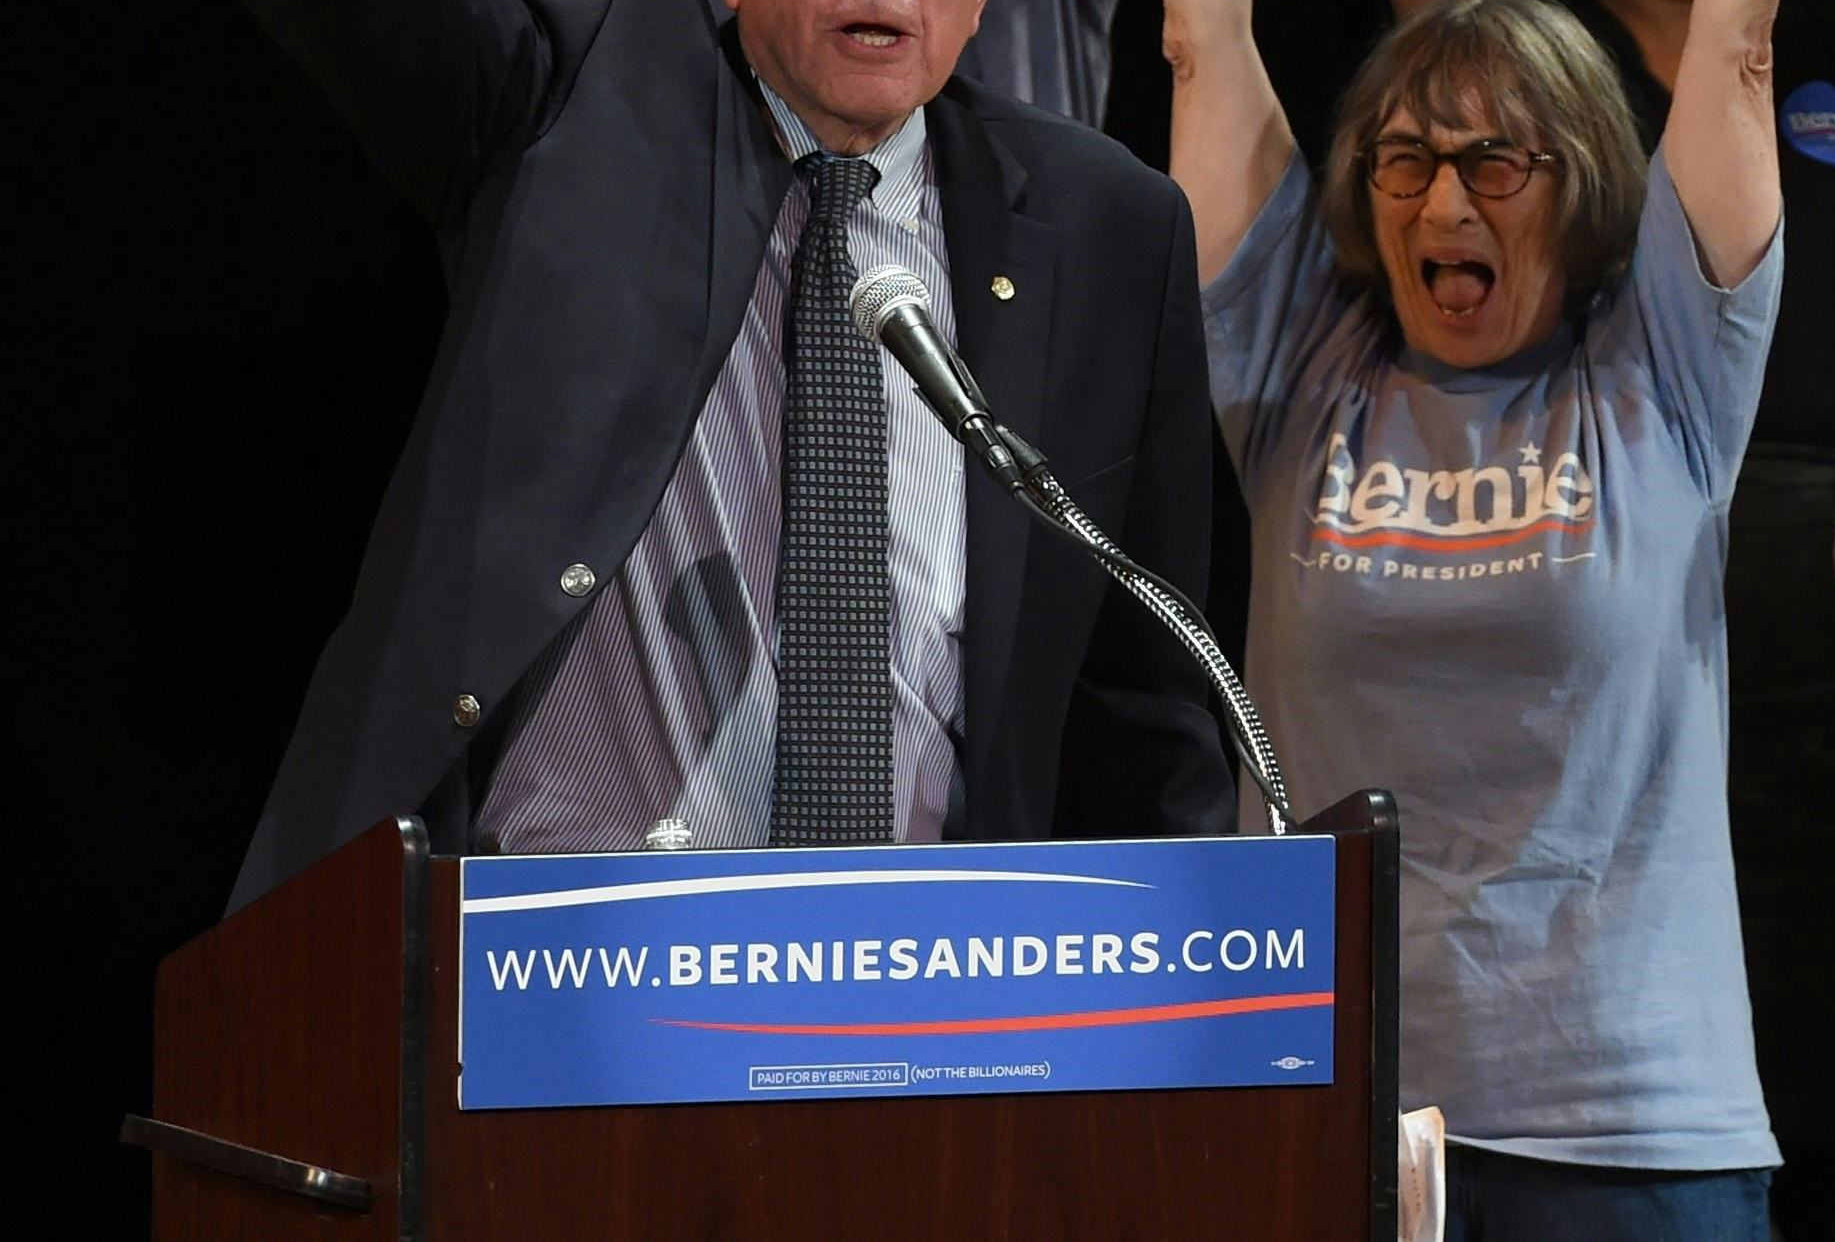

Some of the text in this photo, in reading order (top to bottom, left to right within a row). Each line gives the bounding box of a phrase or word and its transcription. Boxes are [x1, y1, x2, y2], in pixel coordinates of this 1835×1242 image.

[1319, 551, 1543, 581] FOR PRESIDENT
[487, 927, 1305, 991] WWW.BERNIESANDERS.COM
[757, 1061, 1051, 1084] PAID FOR BY BERNIE 2016 (NOT THE BILLIONAIRES)
